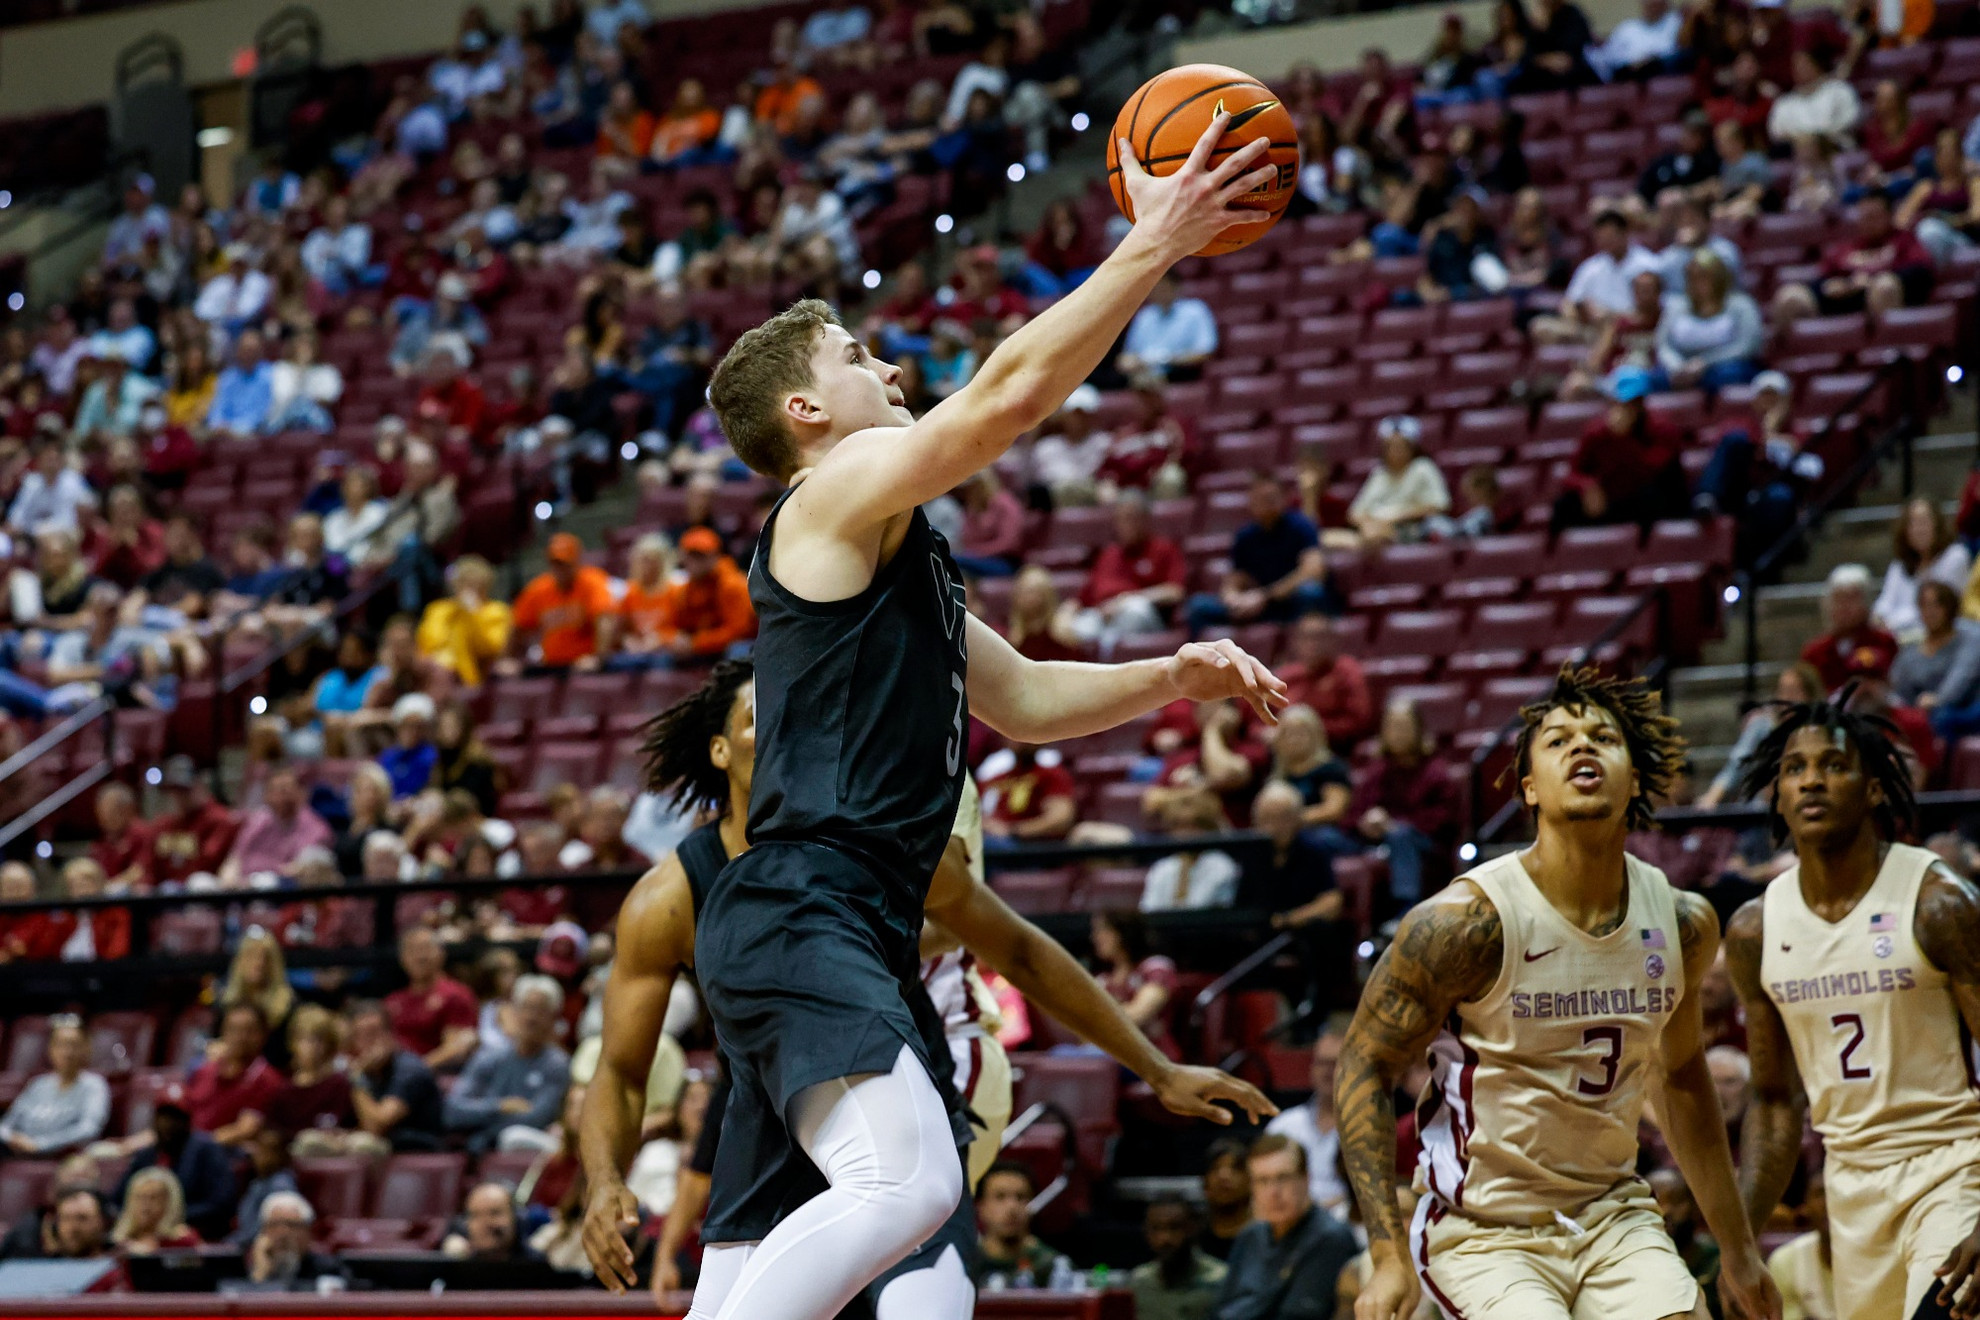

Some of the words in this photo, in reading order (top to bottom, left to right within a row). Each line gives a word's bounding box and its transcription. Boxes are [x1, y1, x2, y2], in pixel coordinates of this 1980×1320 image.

[1512, 988, 1675, 1018] SEMINOLES
[1770, 968, 1916, 1003] SEMINOLES
[1578, 1026, 1623, 1095] 3
[1831, 1013, 1871, 1079] 2
